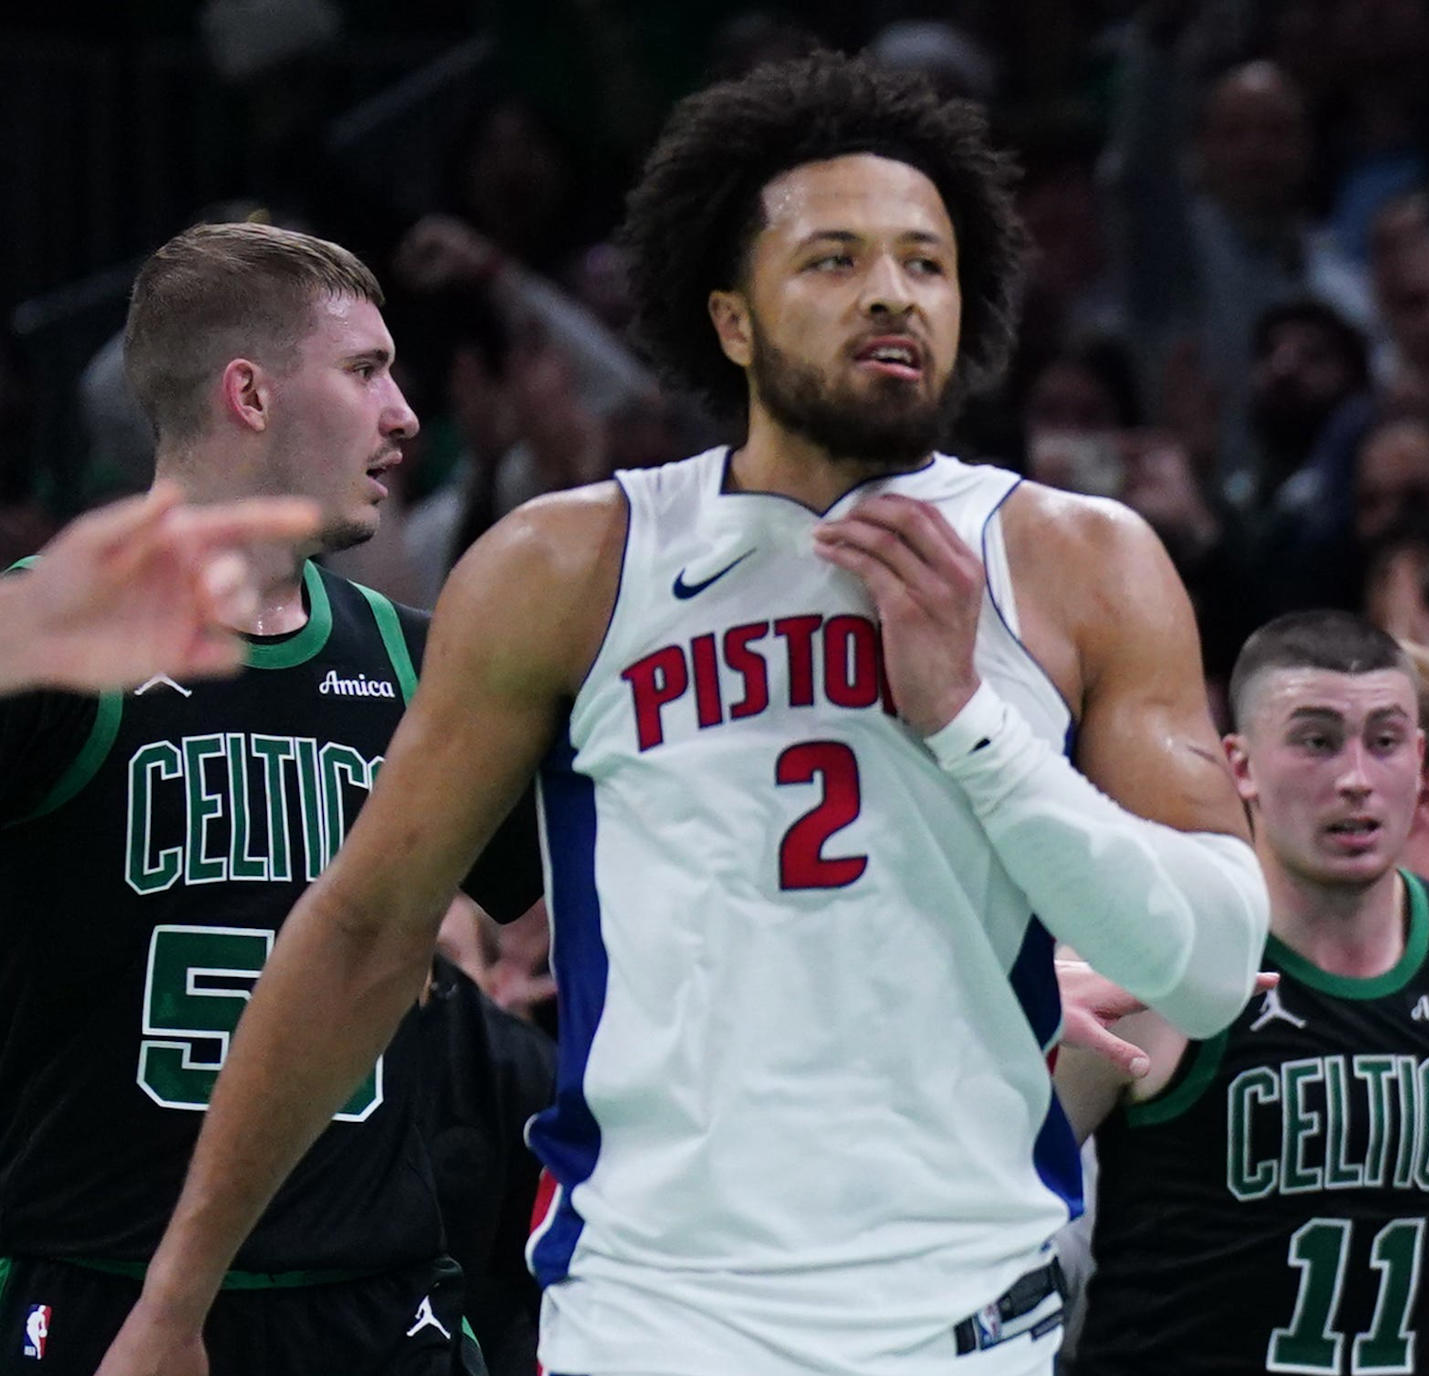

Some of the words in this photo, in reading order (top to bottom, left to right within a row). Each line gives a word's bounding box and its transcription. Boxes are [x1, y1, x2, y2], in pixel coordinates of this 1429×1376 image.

[318, 669, 396, 699] Amica
[621, 613, 899, 753] PISTO
[124, 732, 386, 897] CELTIC
[775, 738, 869, 892] 2
[136, 924, 385, 1123] 5
